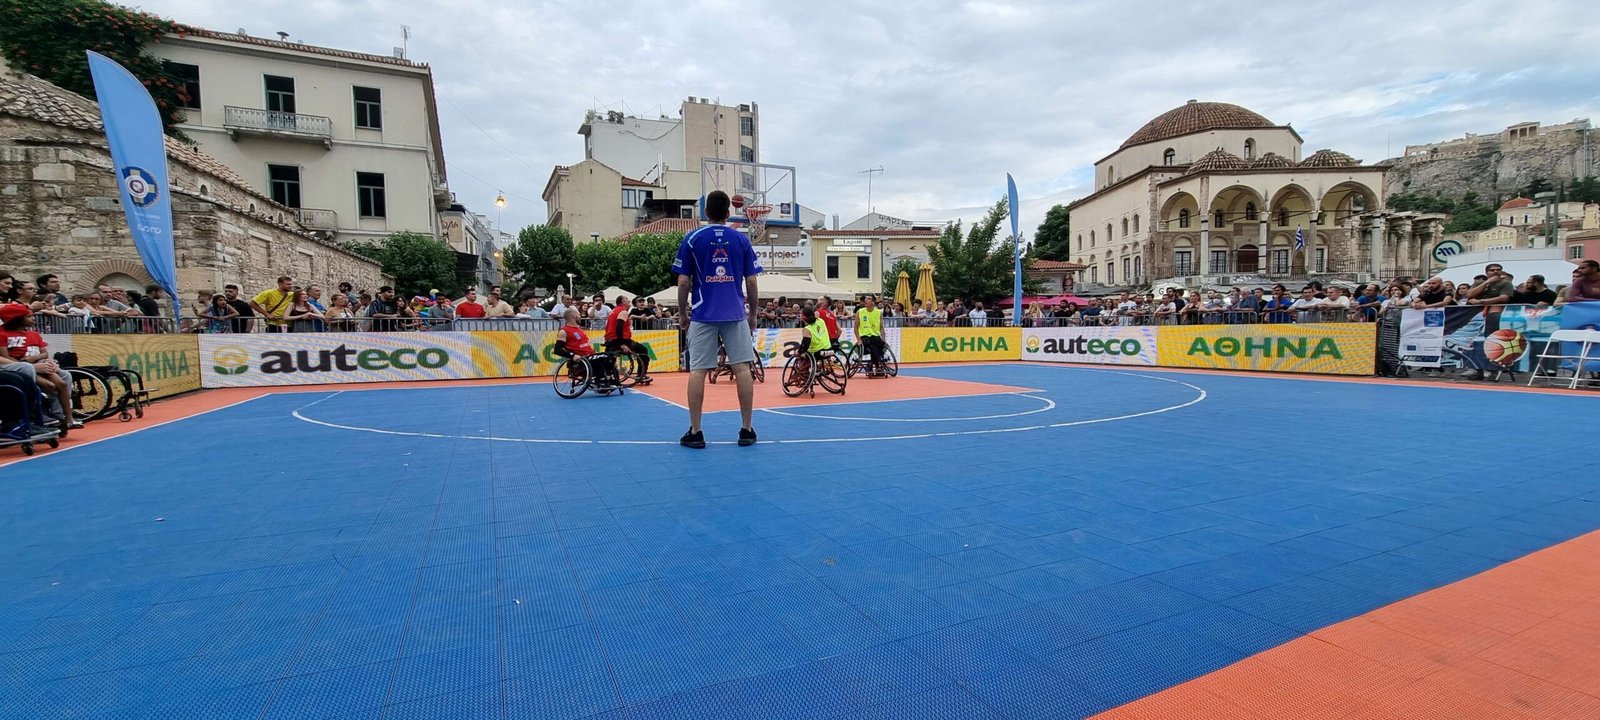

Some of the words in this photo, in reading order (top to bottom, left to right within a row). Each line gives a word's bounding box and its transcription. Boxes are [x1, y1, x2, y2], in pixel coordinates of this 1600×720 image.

[769, 250, 800, 259] project
[923, 336, 1009, 352] ΑΘΗΝΑ
[1043, 335, 1142, 355] auteco
[1187, 337, 1343, 359] ΑΘΗΝΑ
[260, 344, 449, 374] auteco
